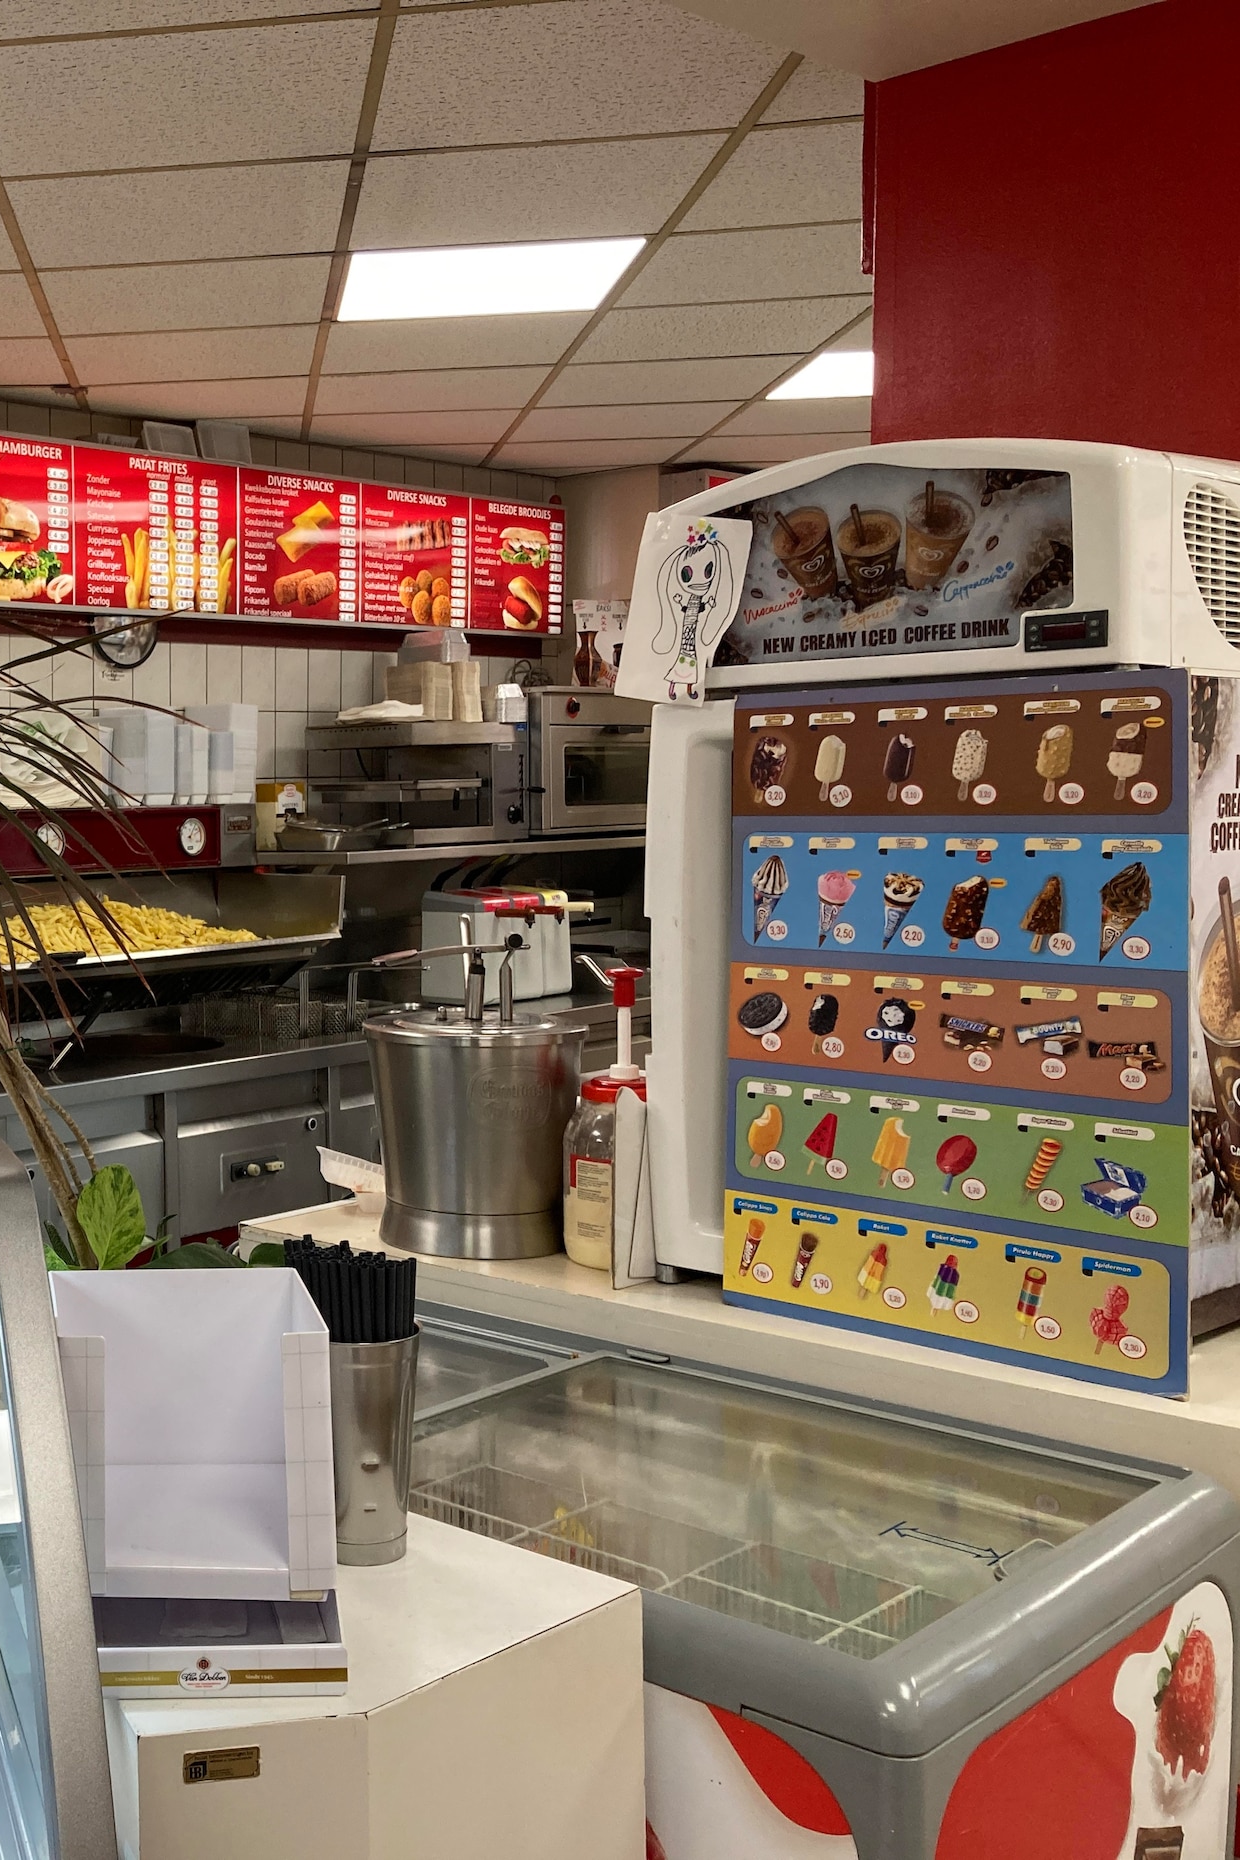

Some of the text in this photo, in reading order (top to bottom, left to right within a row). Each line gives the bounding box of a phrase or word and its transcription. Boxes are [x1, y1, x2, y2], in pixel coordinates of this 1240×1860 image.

[129, 457, 187, 475] PATAT FRITES
[267, 475, 334, 493] DIVERSE SNACKS
[387, 490, 447, 507] DIVERSE SNACKS
[488, 503, 551, 520] BELEGDE BROODJES
[763, 618, 1010, 655] NEW CREAMY ICED COFFEE DRINK
[948, 1017, 987, 1032] SNICKERS
[1033, 1023, 1064, 1035] BOUNTY
[865, 1028, 917, 1044] OREO
[1094, 1261, 1132, 1273] Spiderman
